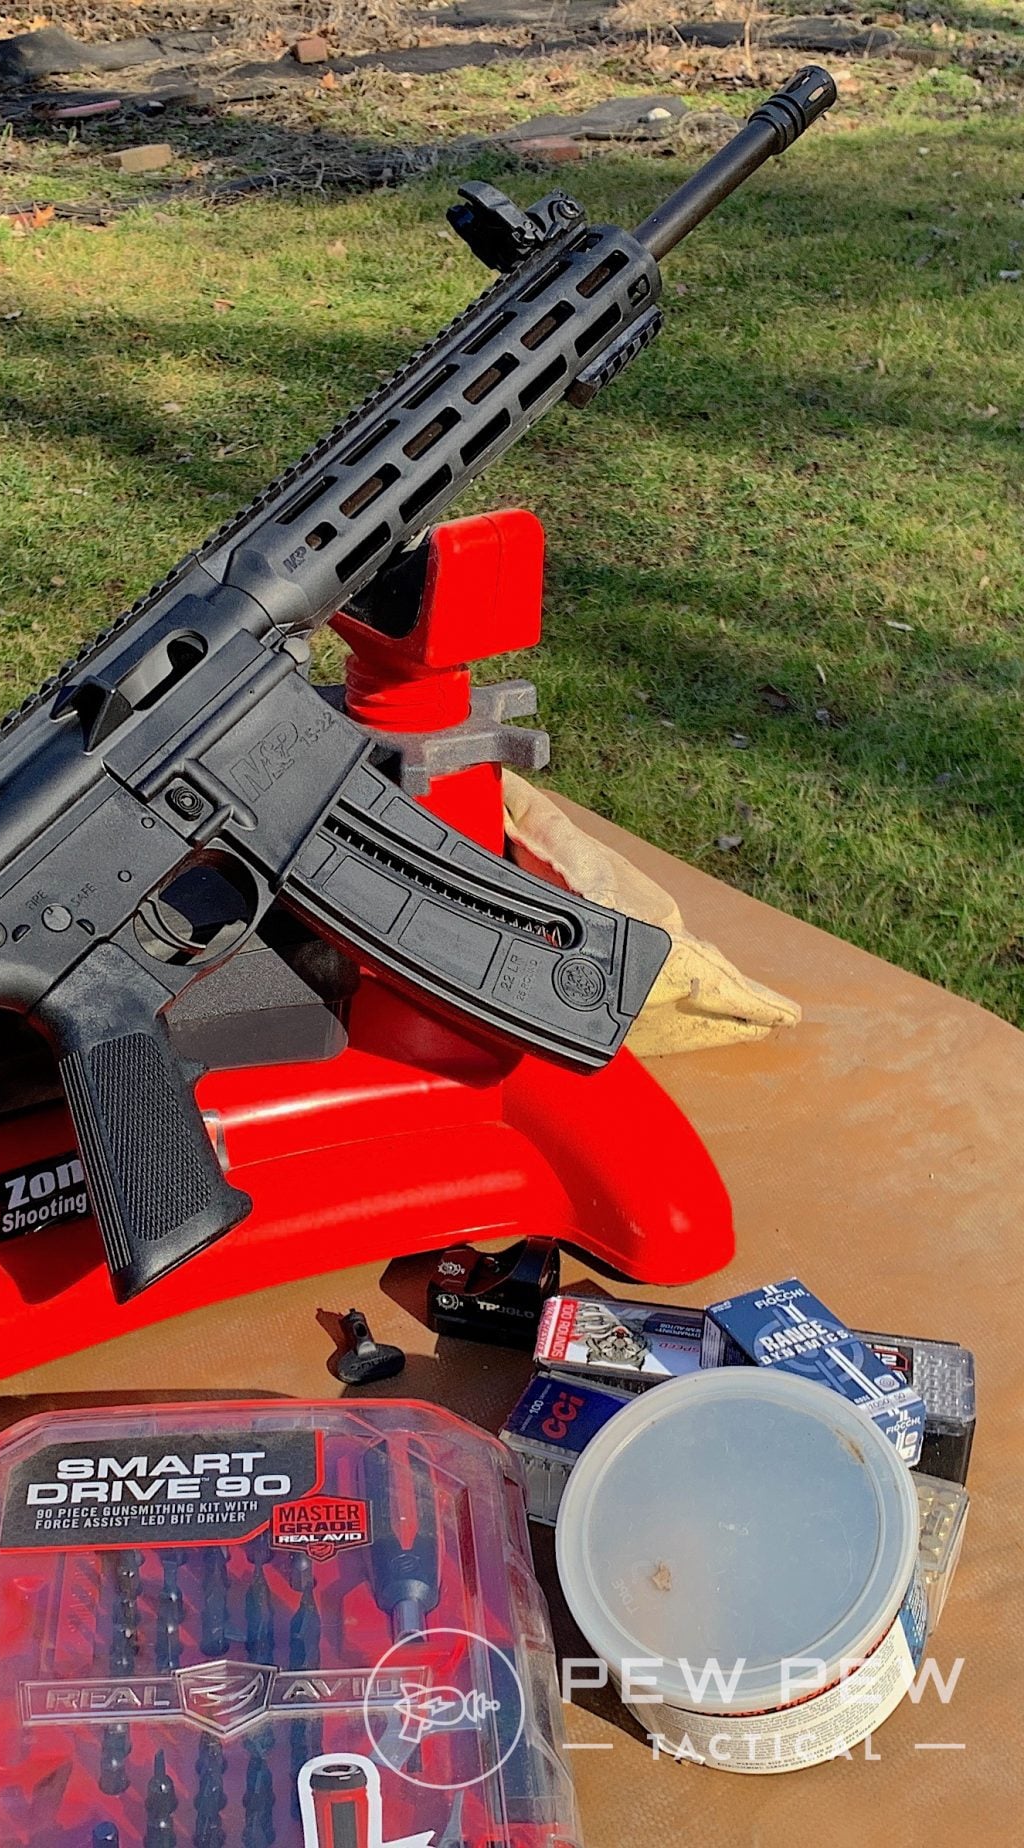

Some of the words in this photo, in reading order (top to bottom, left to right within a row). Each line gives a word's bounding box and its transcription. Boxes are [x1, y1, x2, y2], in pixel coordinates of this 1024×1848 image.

[71, 883, 97, 907] SAFE
[4, 1159, 86, 1211] Zon
[2, 1192, 87, 1233] Shooting
[561, 1303, 575, 1319] 100
[754, 1288, 806, 1310] FIOCCHI
[550, 1319, 571, 1358] ROUNDS
[759, 1320, 828, 1353] RANGE
[760, 1329, 849, 1365] DYNAMICS
[528, 1399, 544, 1416] 100
[57, 1452, 266, 1480] SMART
[215, 1474, 292, 1498] 90
[35, 1518, 80, 1530] FORCE
[141, 1514, 166, 1526] LED
[171, 1513, 194, 1525] BIT
[197, 1512, 246, 1524] DRIVER
[36, 1508, 52, 1519] 90
[58, 1507, 98, 1519] PIECE
[103, 1504, 194, 1517] GUNSMITHING
[199, 1502, 222, 1513] KIT
[225, 1500, 259, 1512] WITH
[279, 1504, 359, 1522] MASTER
[278, 1534, 319, 1543] REAL
[323, 1532, 362, 1542] AVID
[279, 1520, 361, 1533] GRADE
[45, 1686, 171, 1711] REAL
